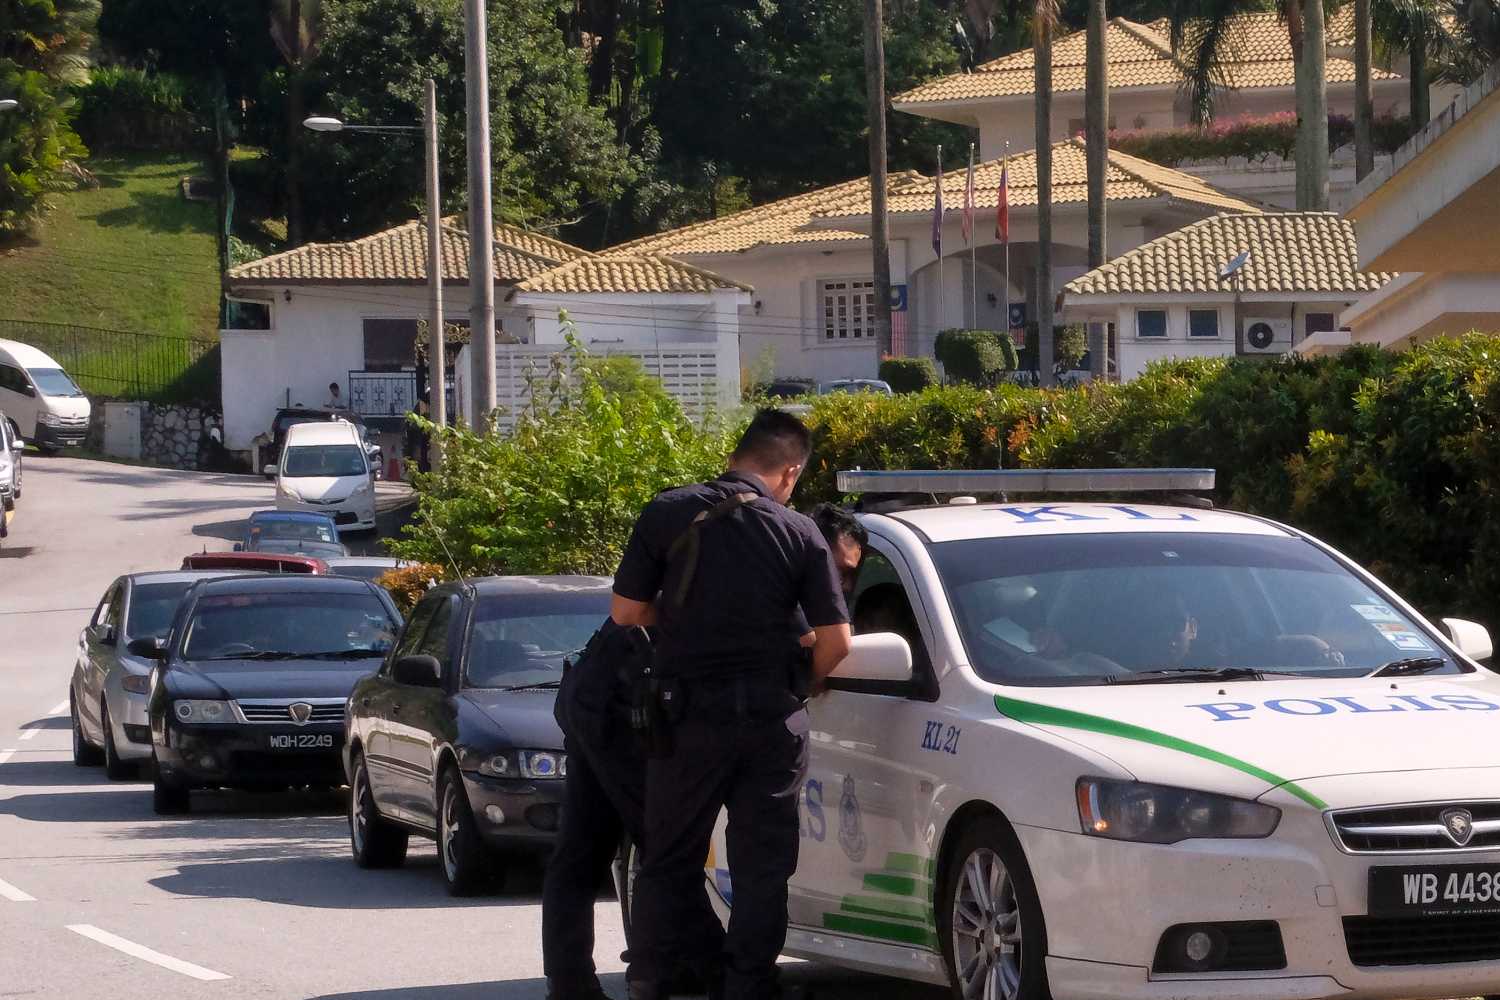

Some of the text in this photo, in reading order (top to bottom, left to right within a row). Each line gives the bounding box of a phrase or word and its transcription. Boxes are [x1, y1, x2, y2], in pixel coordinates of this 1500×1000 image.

[983, 506, 1200, 524] KL
[1184, 695, 1500, 722] POLIS
[921, 720, 962, 755] KL 21
[1403, 872, 1438, 905] WB
